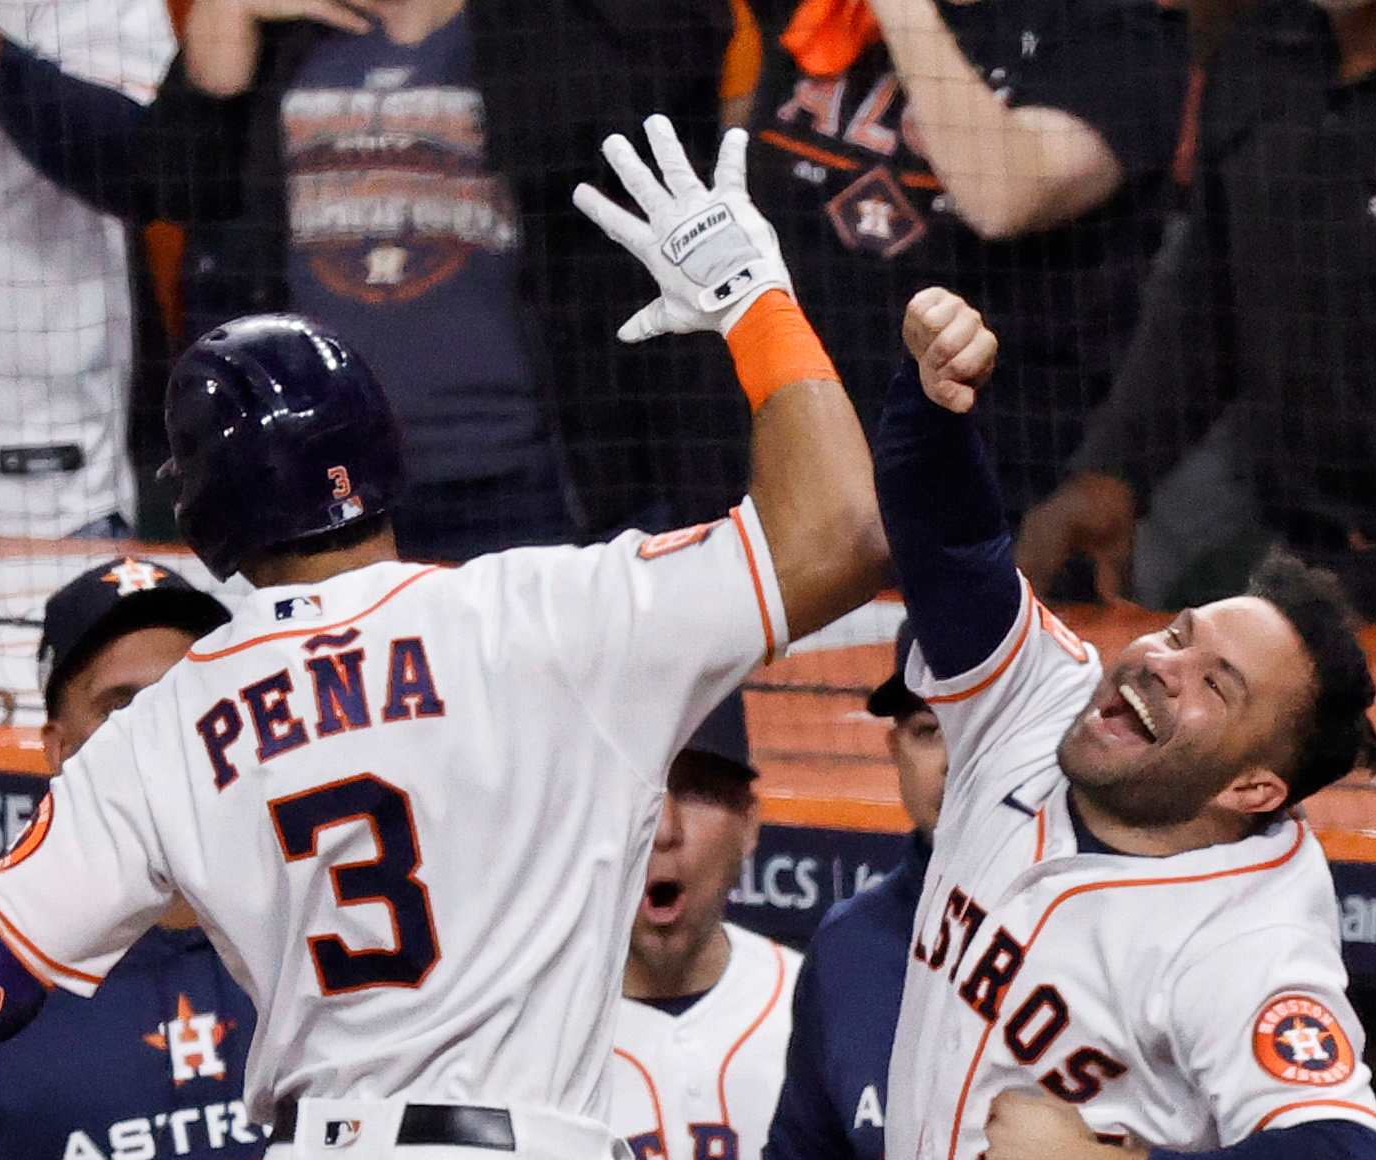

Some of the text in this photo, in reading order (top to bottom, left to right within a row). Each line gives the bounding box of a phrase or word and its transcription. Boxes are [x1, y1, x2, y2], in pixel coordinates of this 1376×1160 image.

[327, 465, 351, 500] 3
[195, 627, 446, 793] PEÑA
[266, 771, 443, 997] 3
[729, 855, 819, 910] LCS
